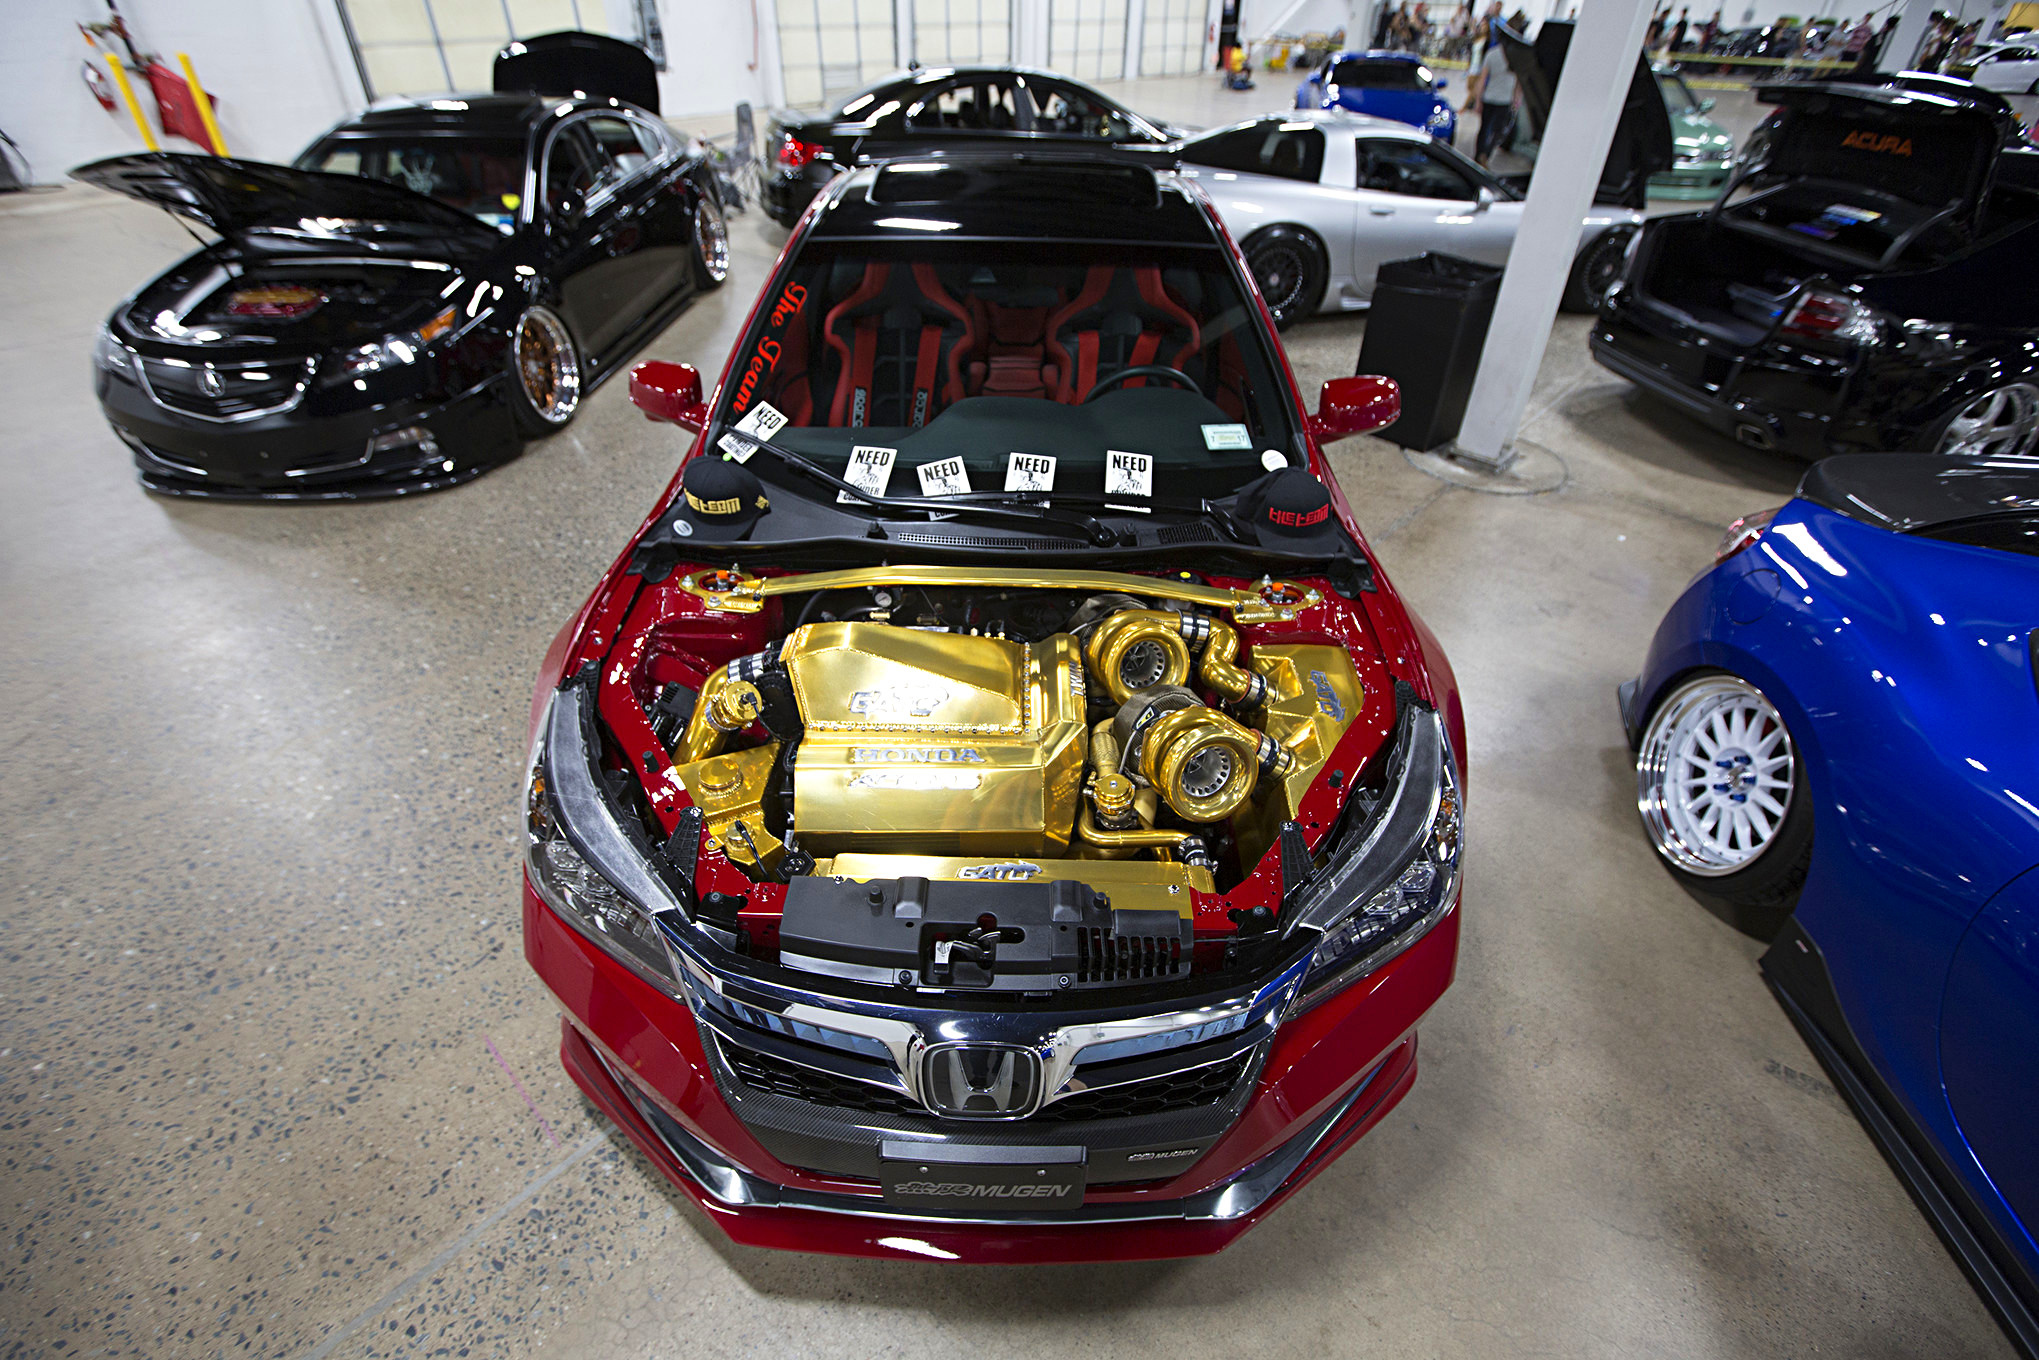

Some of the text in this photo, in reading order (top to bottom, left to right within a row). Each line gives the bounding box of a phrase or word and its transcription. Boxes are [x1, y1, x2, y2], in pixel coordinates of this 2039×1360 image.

[1841, 130, 1912, 157] ACURA
[733, 281, 807, 415] The Team
[755, 406, 782, 429] NEED
[913, 391, 927, 428] parco
[854, 449, 891, 467] NEED
[1014, 456, 1050, 474] NEED
[1112, 454, 1147, 473] NEED
[923, 460, 960, 482] NEED
[854, 748, 985, 762] HONDA
[1154, 1148, 1199, 1160] MUGEN
[971, 1183, 1073, 1198] MUGEN
